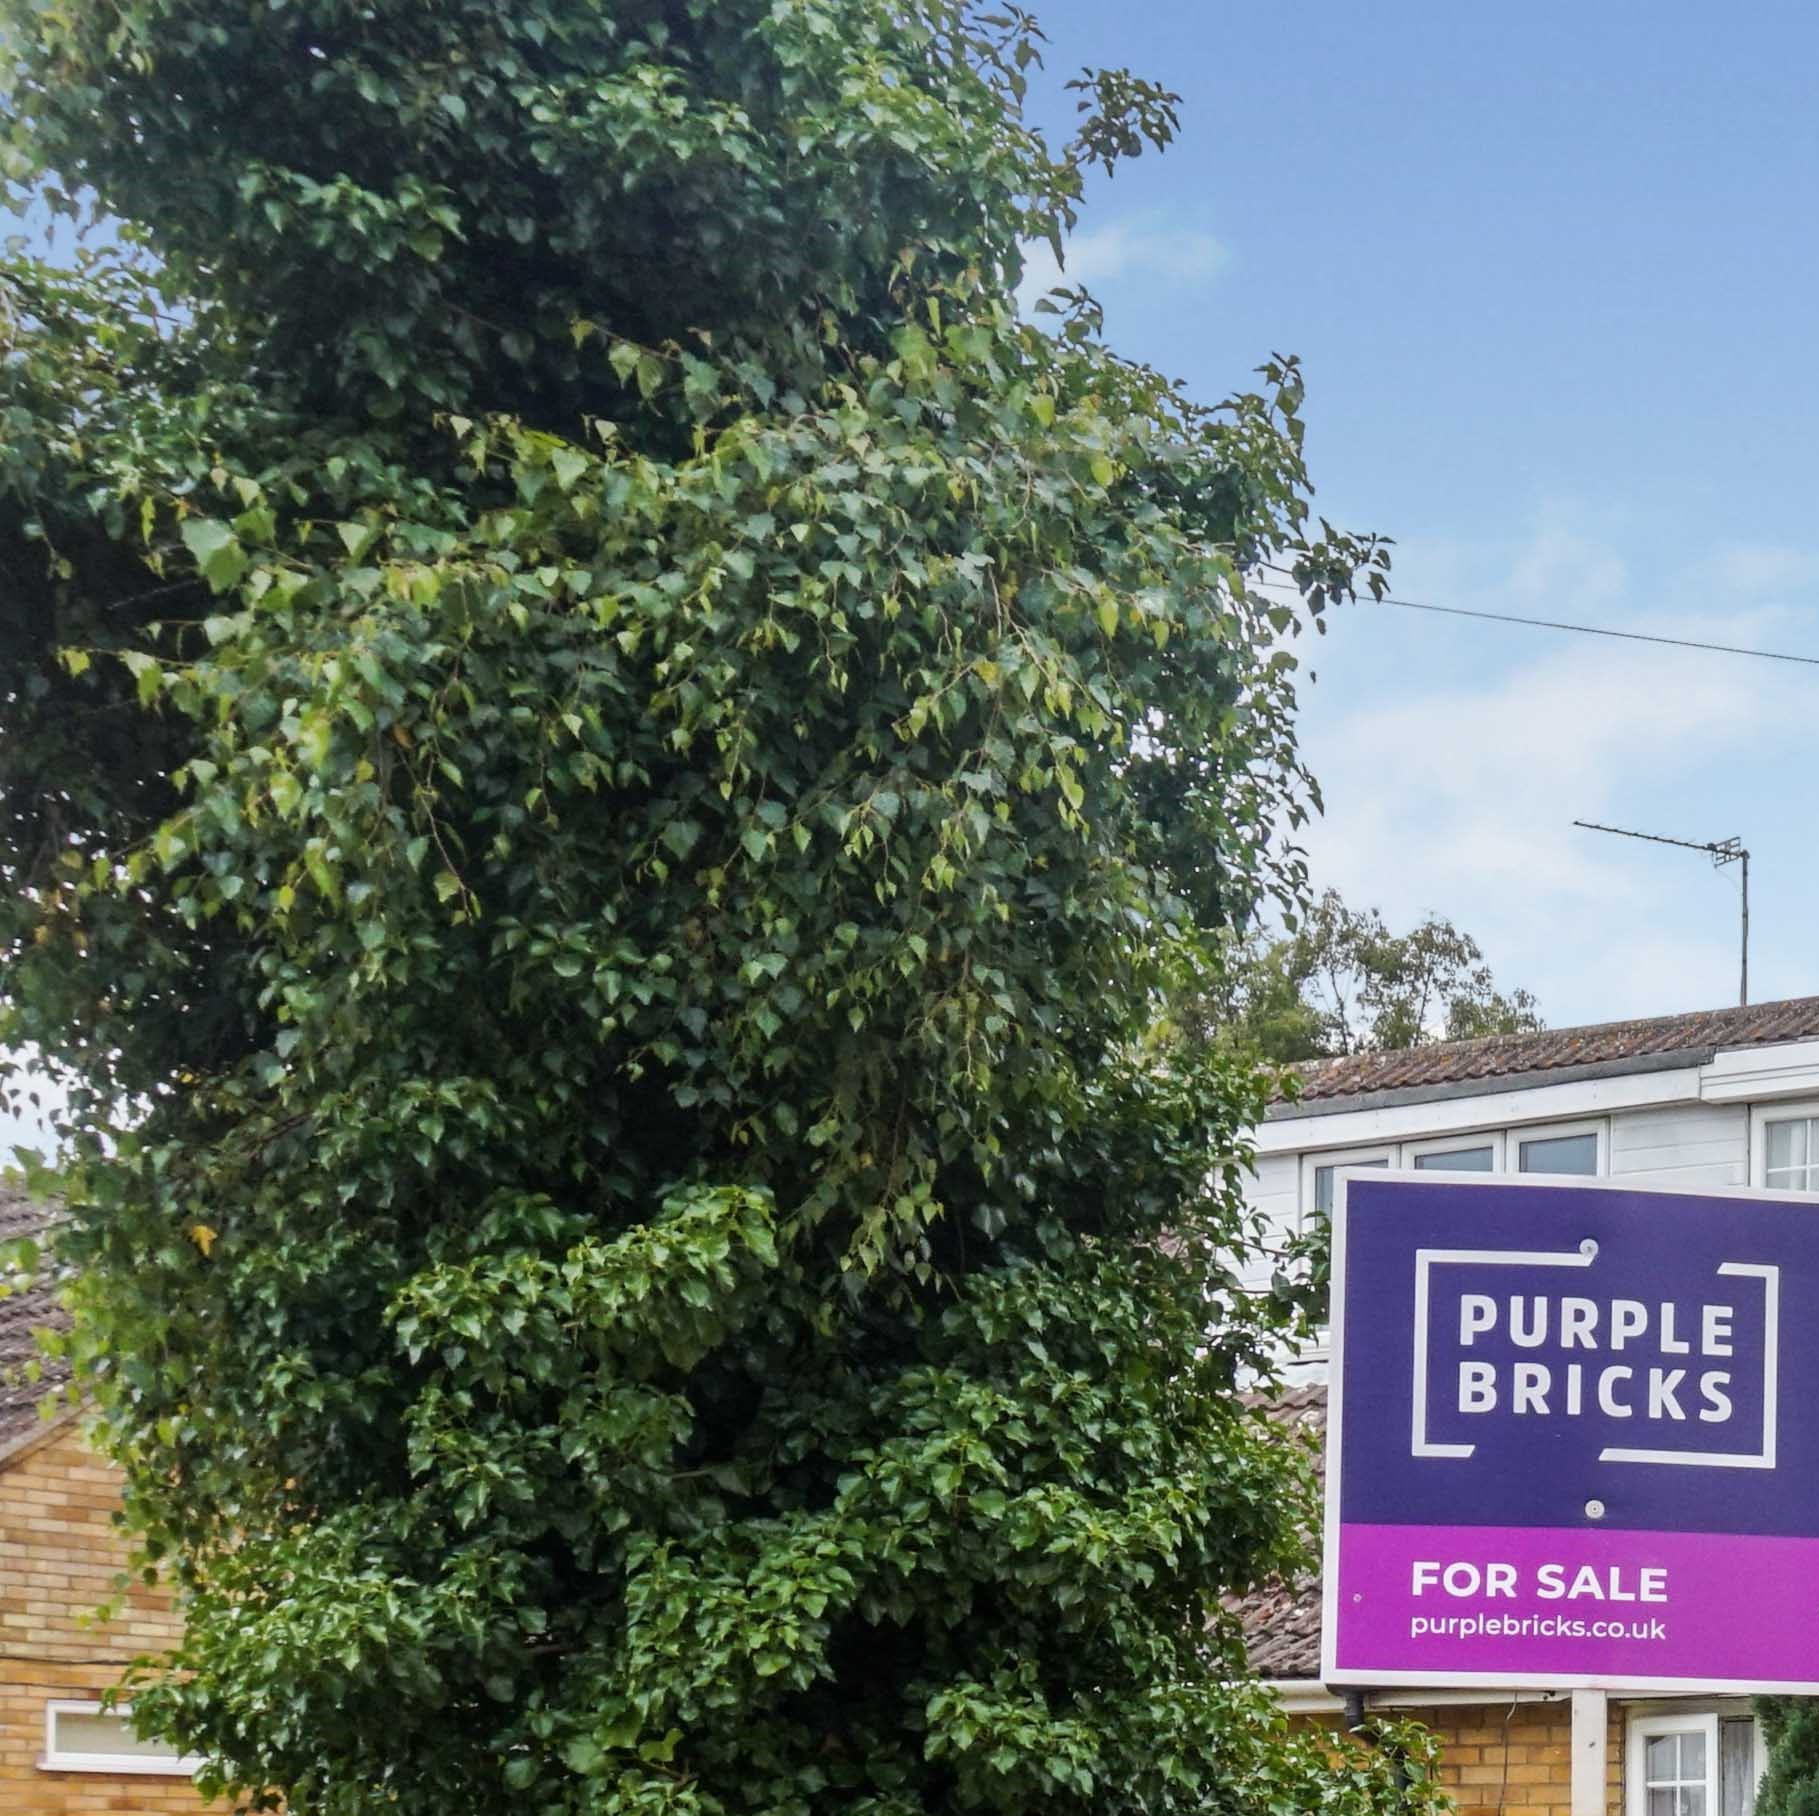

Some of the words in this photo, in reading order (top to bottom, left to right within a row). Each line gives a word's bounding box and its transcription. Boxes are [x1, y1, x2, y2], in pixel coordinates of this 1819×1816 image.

[1459, 1294, 1734, 1357] PURPLE
[1458, 1361, 1733, 1423] BRICKS
[1411, 1561, 1518, 1599] FOR
[1536, 1563, 1669, 1603] SALE
[1411, 1613, 1667, 1641] purplebricks.co.uk
